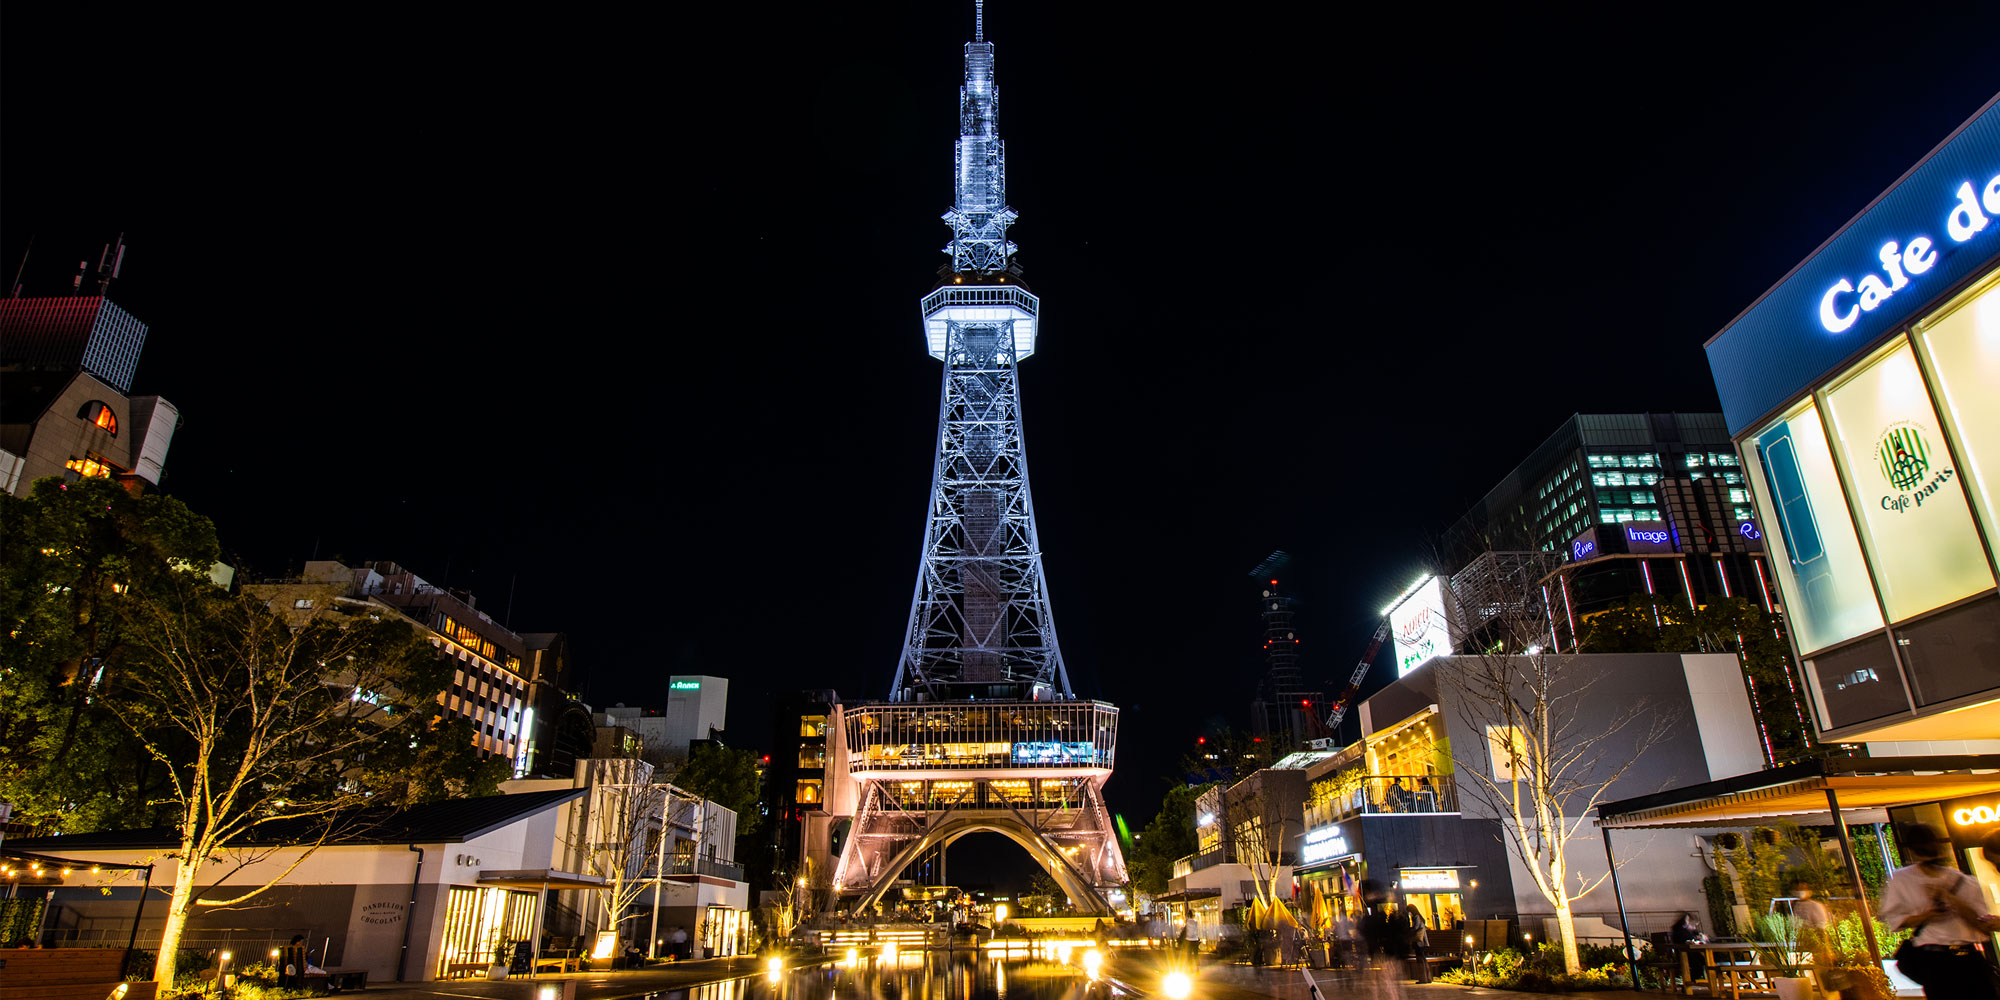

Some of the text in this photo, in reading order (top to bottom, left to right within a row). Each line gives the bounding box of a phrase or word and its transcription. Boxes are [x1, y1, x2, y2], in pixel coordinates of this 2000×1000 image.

[1820, 237, 1937, 333] Cafe
[1914, 466, 1953, 507] paris
[1628, 527, 1668, 544] Image
[362, 902, 404, 912] DANDELION
[360, 914, 402, 925] CHOCOLATE
